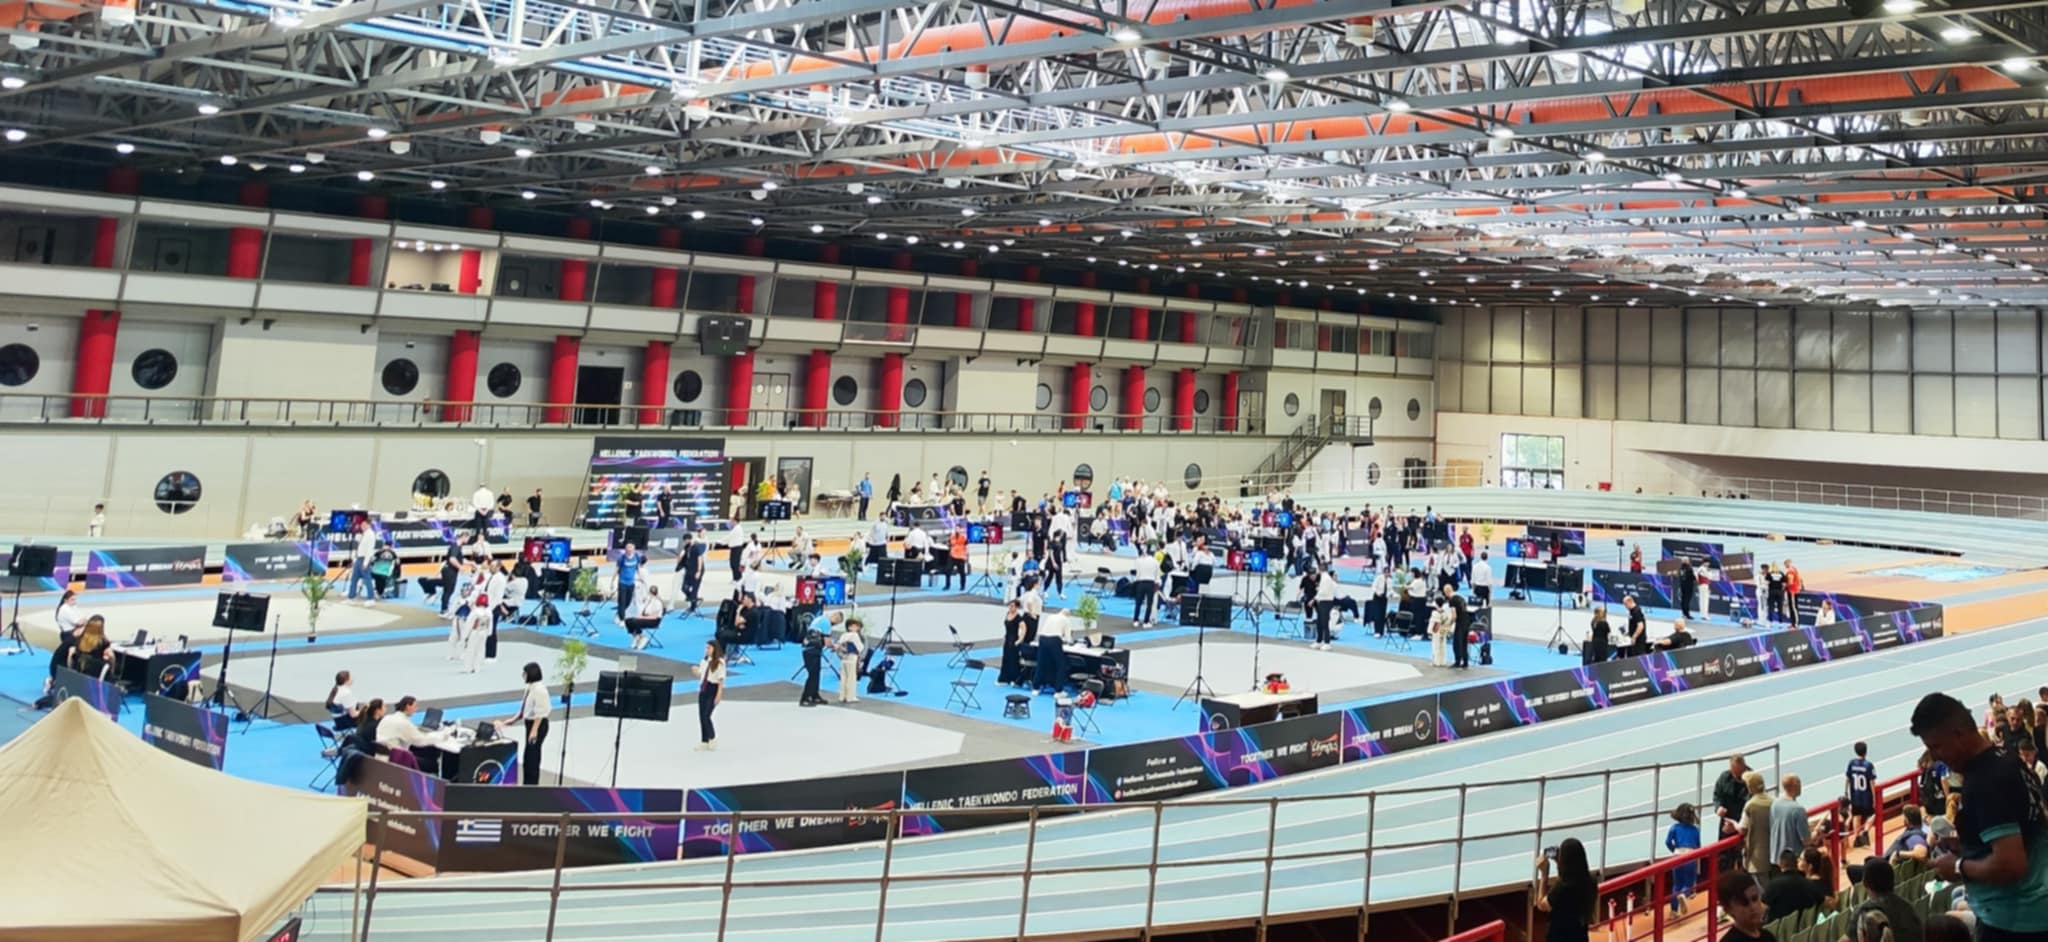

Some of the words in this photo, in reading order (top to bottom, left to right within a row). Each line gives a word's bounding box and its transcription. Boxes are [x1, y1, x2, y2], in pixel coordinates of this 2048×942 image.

[1240, 748, 1275, 765] TOGETHER
[1852, 773, 1867, 791] 10
[959, 789, 1018, 808] TAEKWONDO
[1022, 783, 1078, 801] FEDERATION
[587, 824, 608, 838] WE
[614, 823, 656, 837] FIGHT
[775, 816, 795, 829] WE
